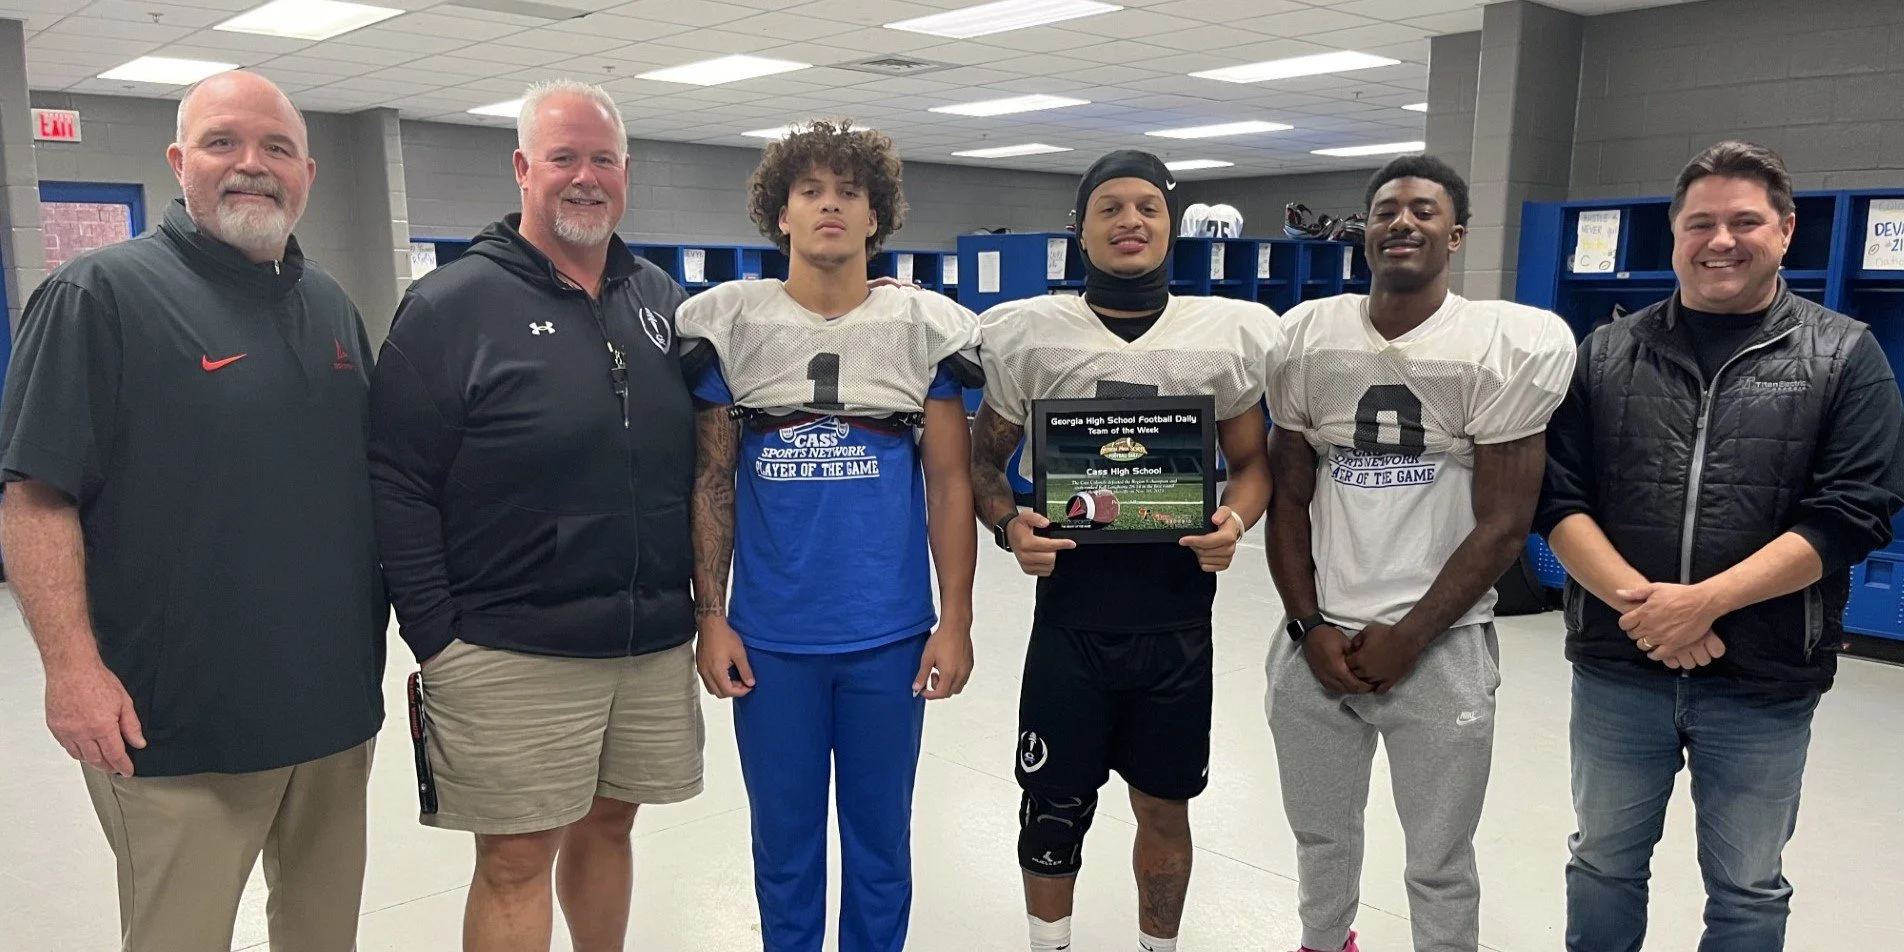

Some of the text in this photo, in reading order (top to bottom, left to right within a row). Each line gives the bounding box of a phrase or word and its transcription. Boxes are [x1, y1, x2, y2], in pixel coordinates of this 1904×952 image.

[40, 113, 74, 137] EXIT
[803, 352, 845, 410] 1
[1051, 414, 1197, 426] Georgia High School Football Daily
[1088, 427, 1108, 435] Team
[1137, 426, 1159, 434] Week
[794, 433, 839, 448] CASS
[762, 446, 866, 458] SPORTS NETWORK
[755, 460, 879, 477] PLAYER OF THE GAME
[1086, 467, 1162, 476] Cass High School
[1356, 472, 1368, 485] OF
[1397, 468, 1435, 483] GAME
